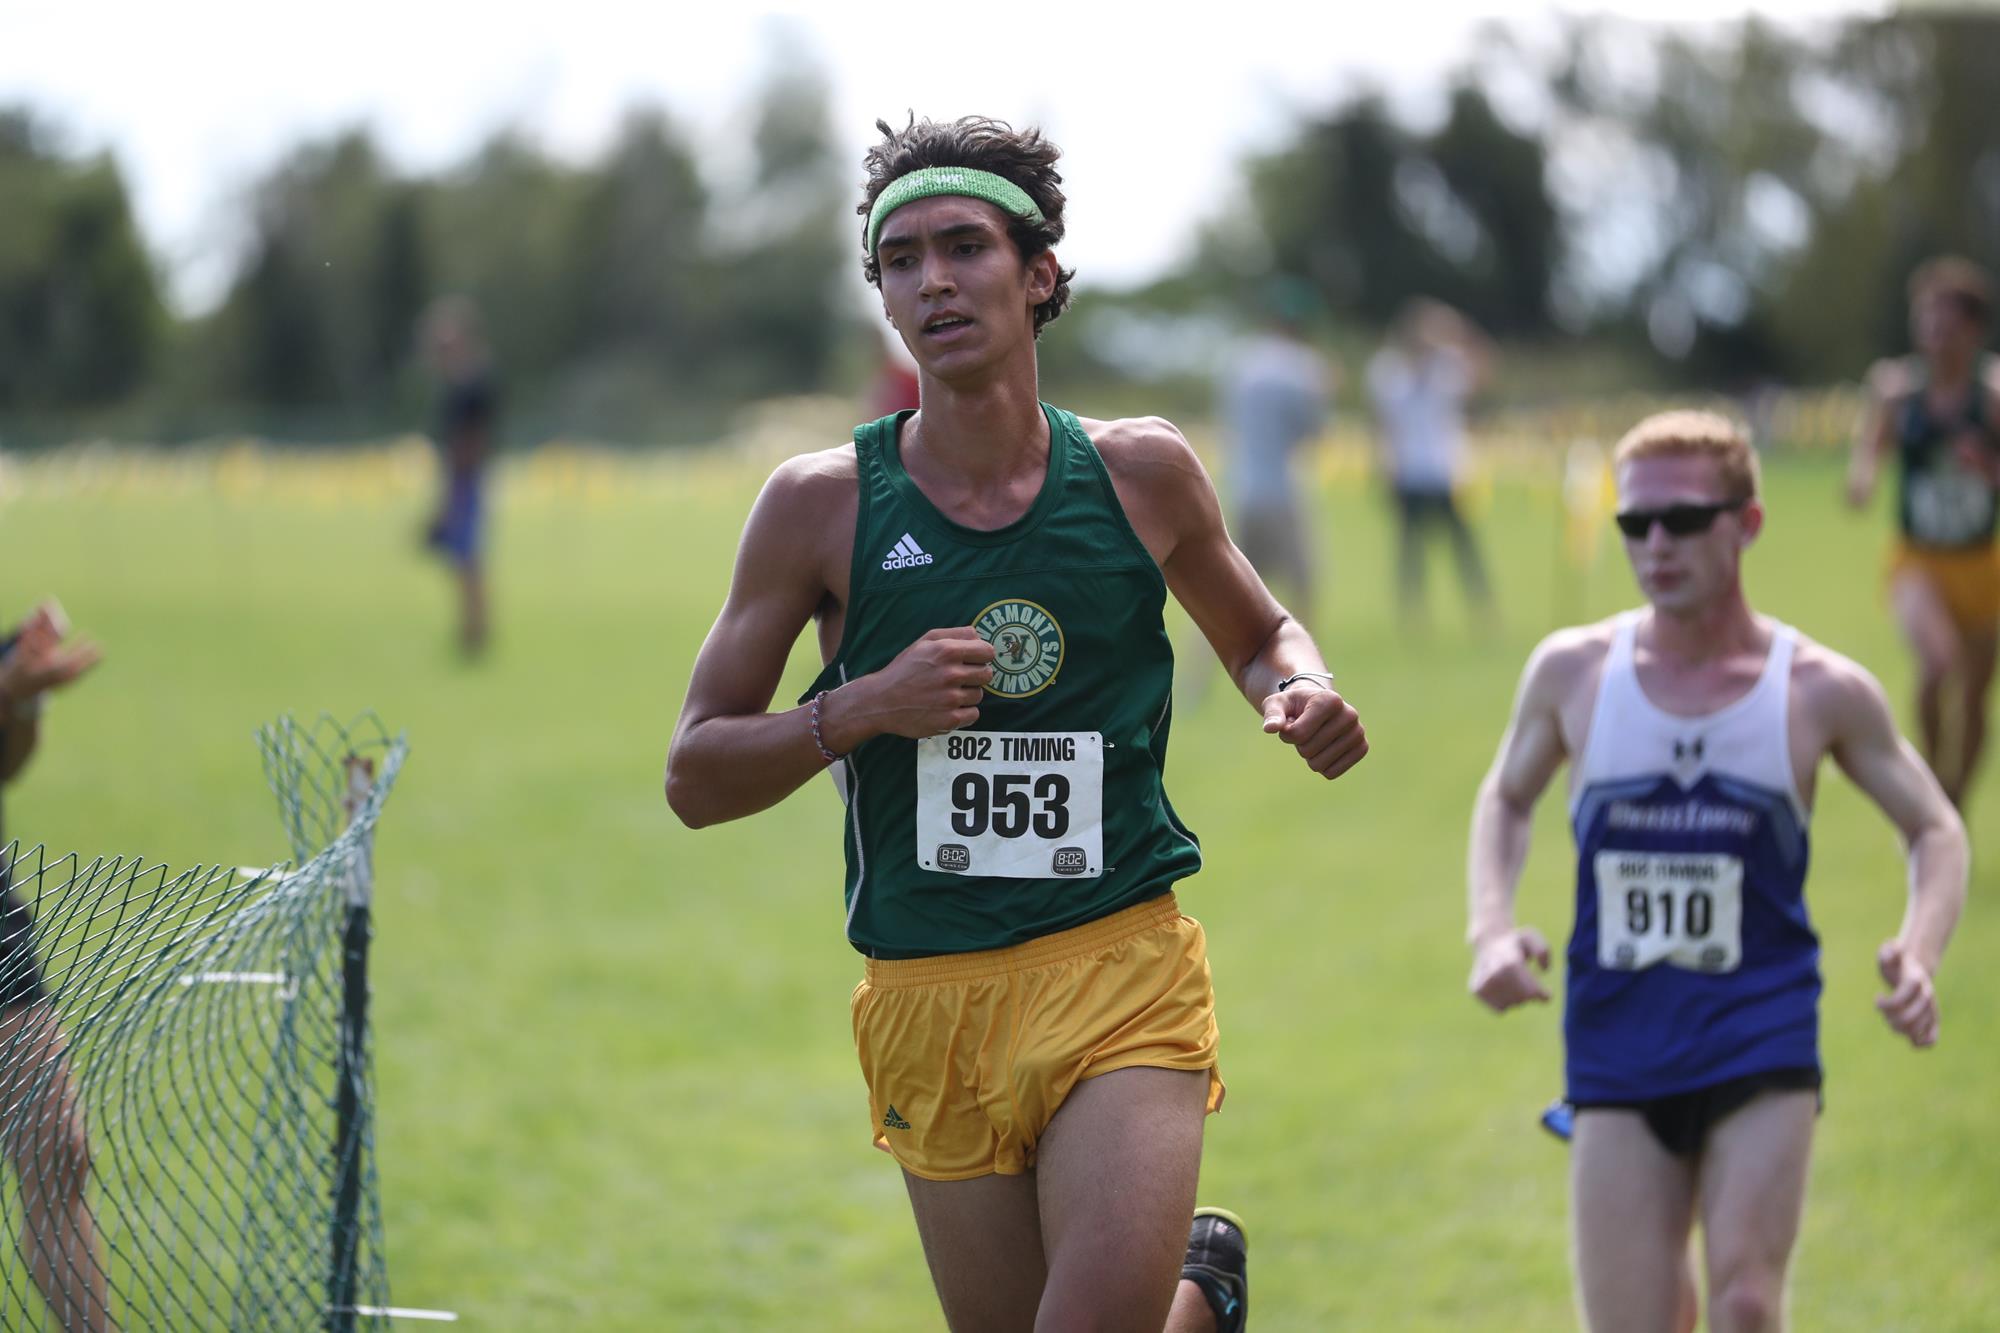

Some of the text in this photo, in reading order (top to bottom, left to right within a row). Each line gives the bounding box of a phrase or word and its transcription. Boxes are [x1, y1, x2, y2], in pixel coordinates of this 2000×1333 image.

[882, 552, 933, 570] adidas
[947, 736, 1075, 762] 802 TIMING
[951, 772, 1070, 839] 953
[942, 849, 967, 862] 8:02
[1058, 853, 1082, 865] 8:02
[1627, 889, 1713, 940] 910
